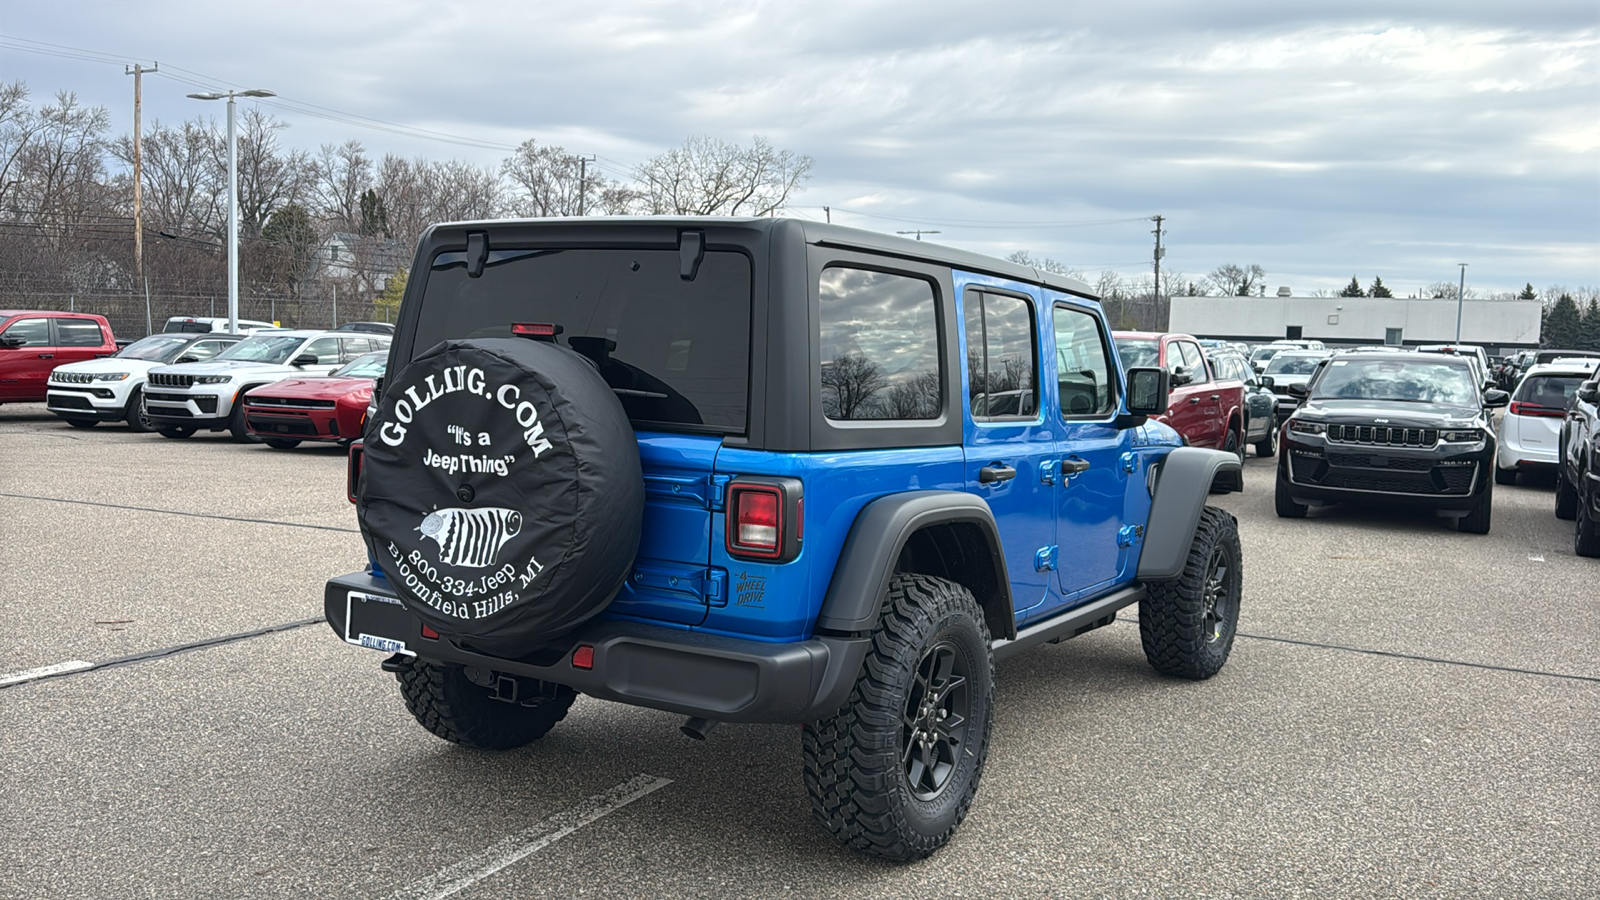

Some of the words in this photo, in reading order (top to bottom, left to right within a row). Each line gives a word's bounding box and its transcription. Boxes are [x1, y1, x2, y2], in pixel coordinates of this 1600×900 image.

[380, 365, 553, 458] GOLLING.COM
[477, 431, 491, 446] a
[387, 541, 470, 620] Bloomfield
[472, 590, 520, 619] Hills,
[519, 556, 545, 589] MI
[407, 549, 516, 597] 800-334-Jeep
[736, 580, 765, 593] WHEEL
[736, 592, 765, 606] DRIVE
